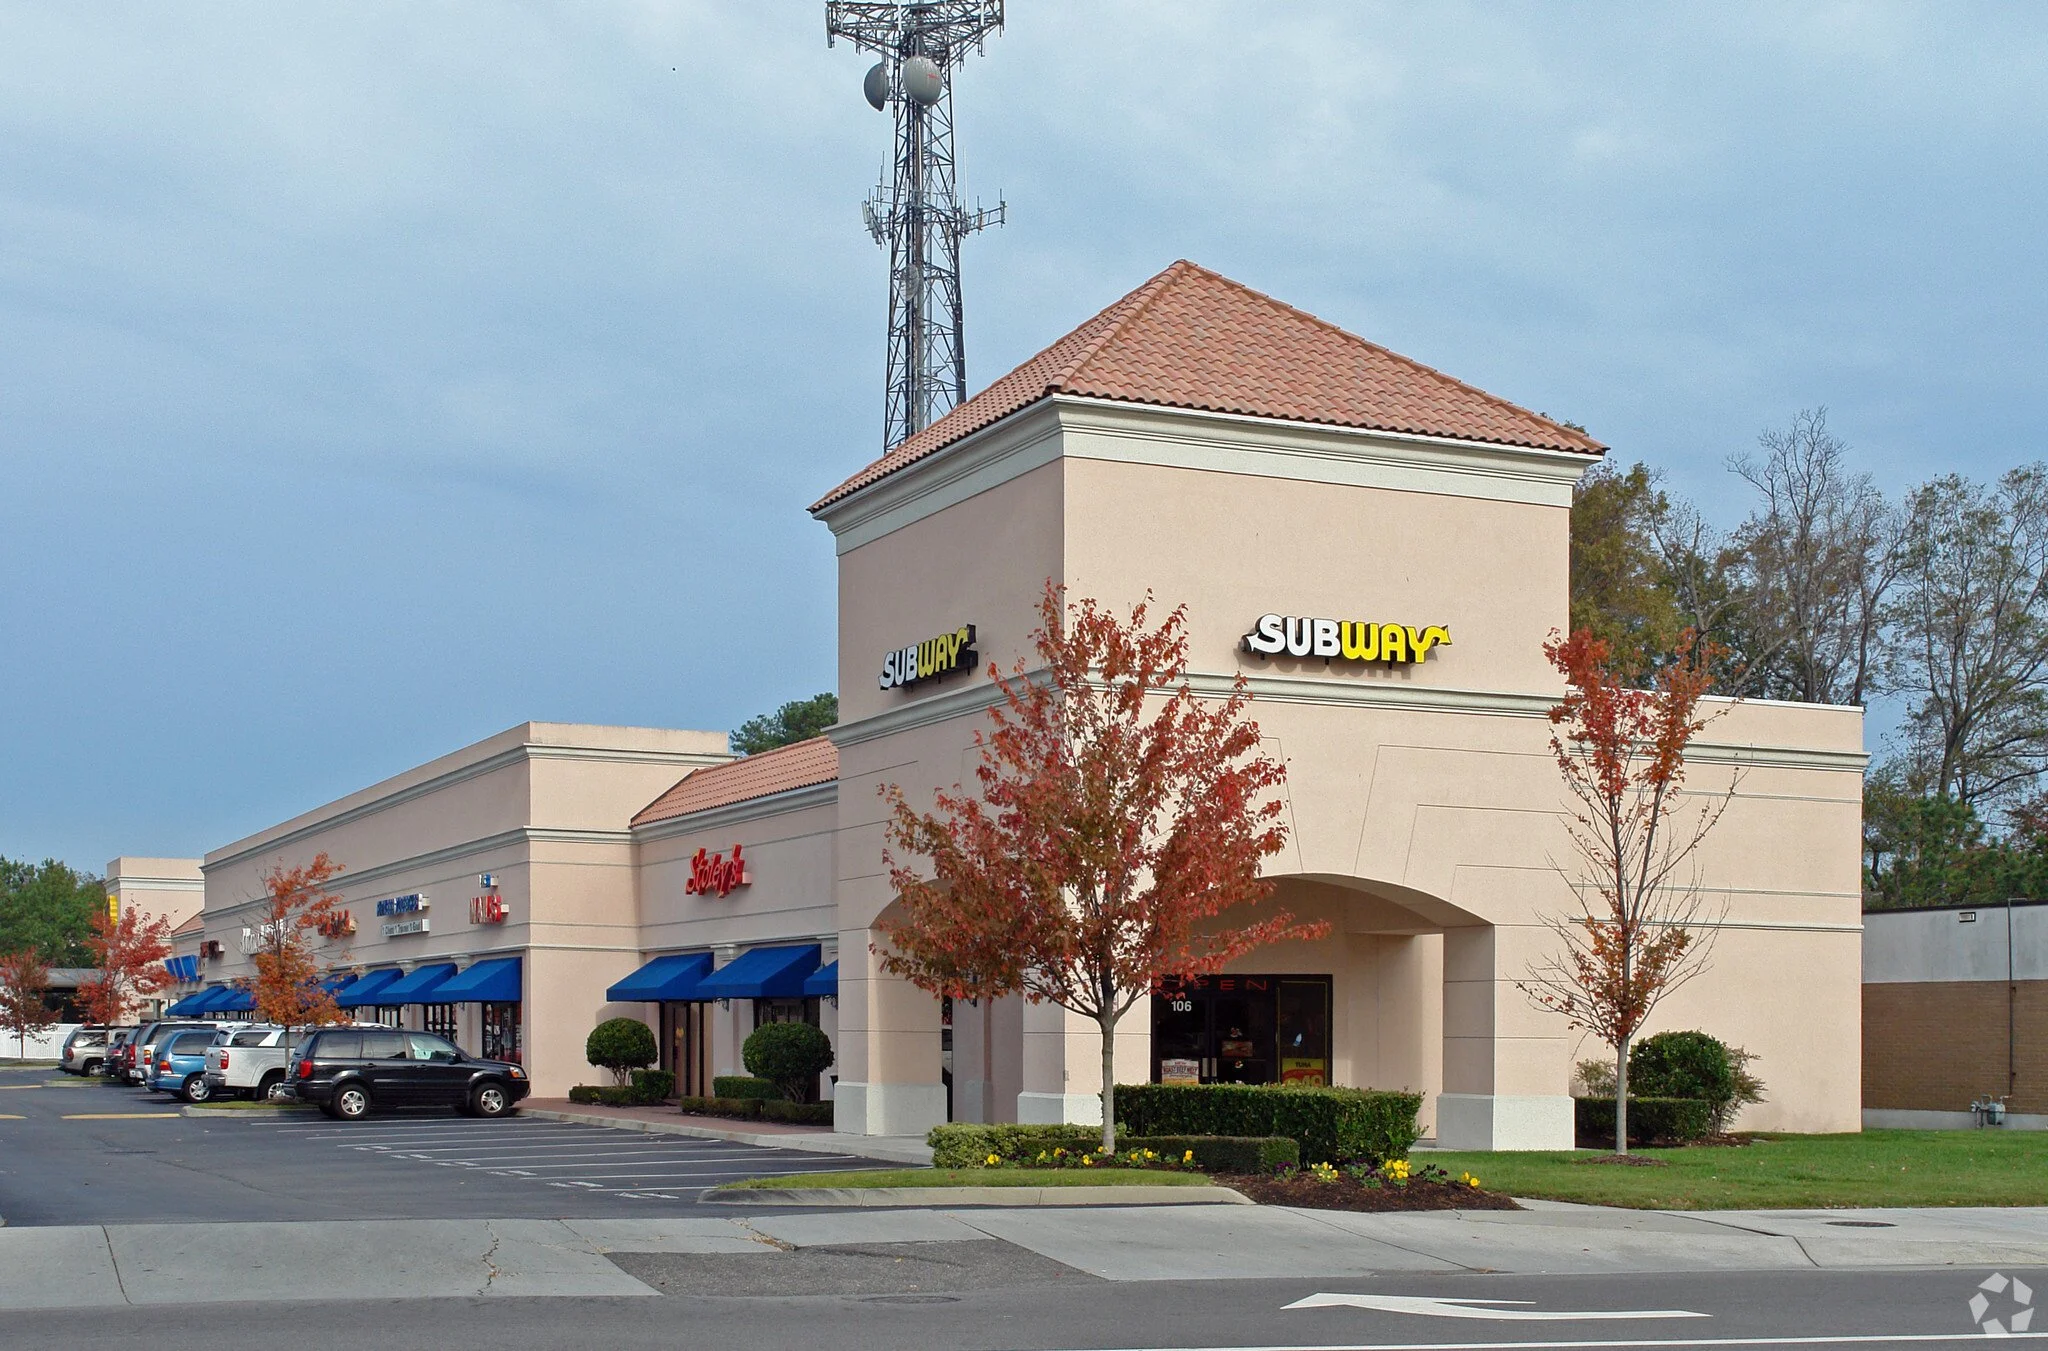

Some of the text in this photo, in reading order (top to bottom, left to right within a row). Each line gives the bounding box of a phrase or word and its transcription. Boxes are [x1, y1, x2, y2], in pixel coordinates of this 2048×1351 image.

[879, 626, 970, 689] SUBWAY
[1247, 613, 1452, 663] SUBWAY
[1171, 1001, 1192, 1012] 106
